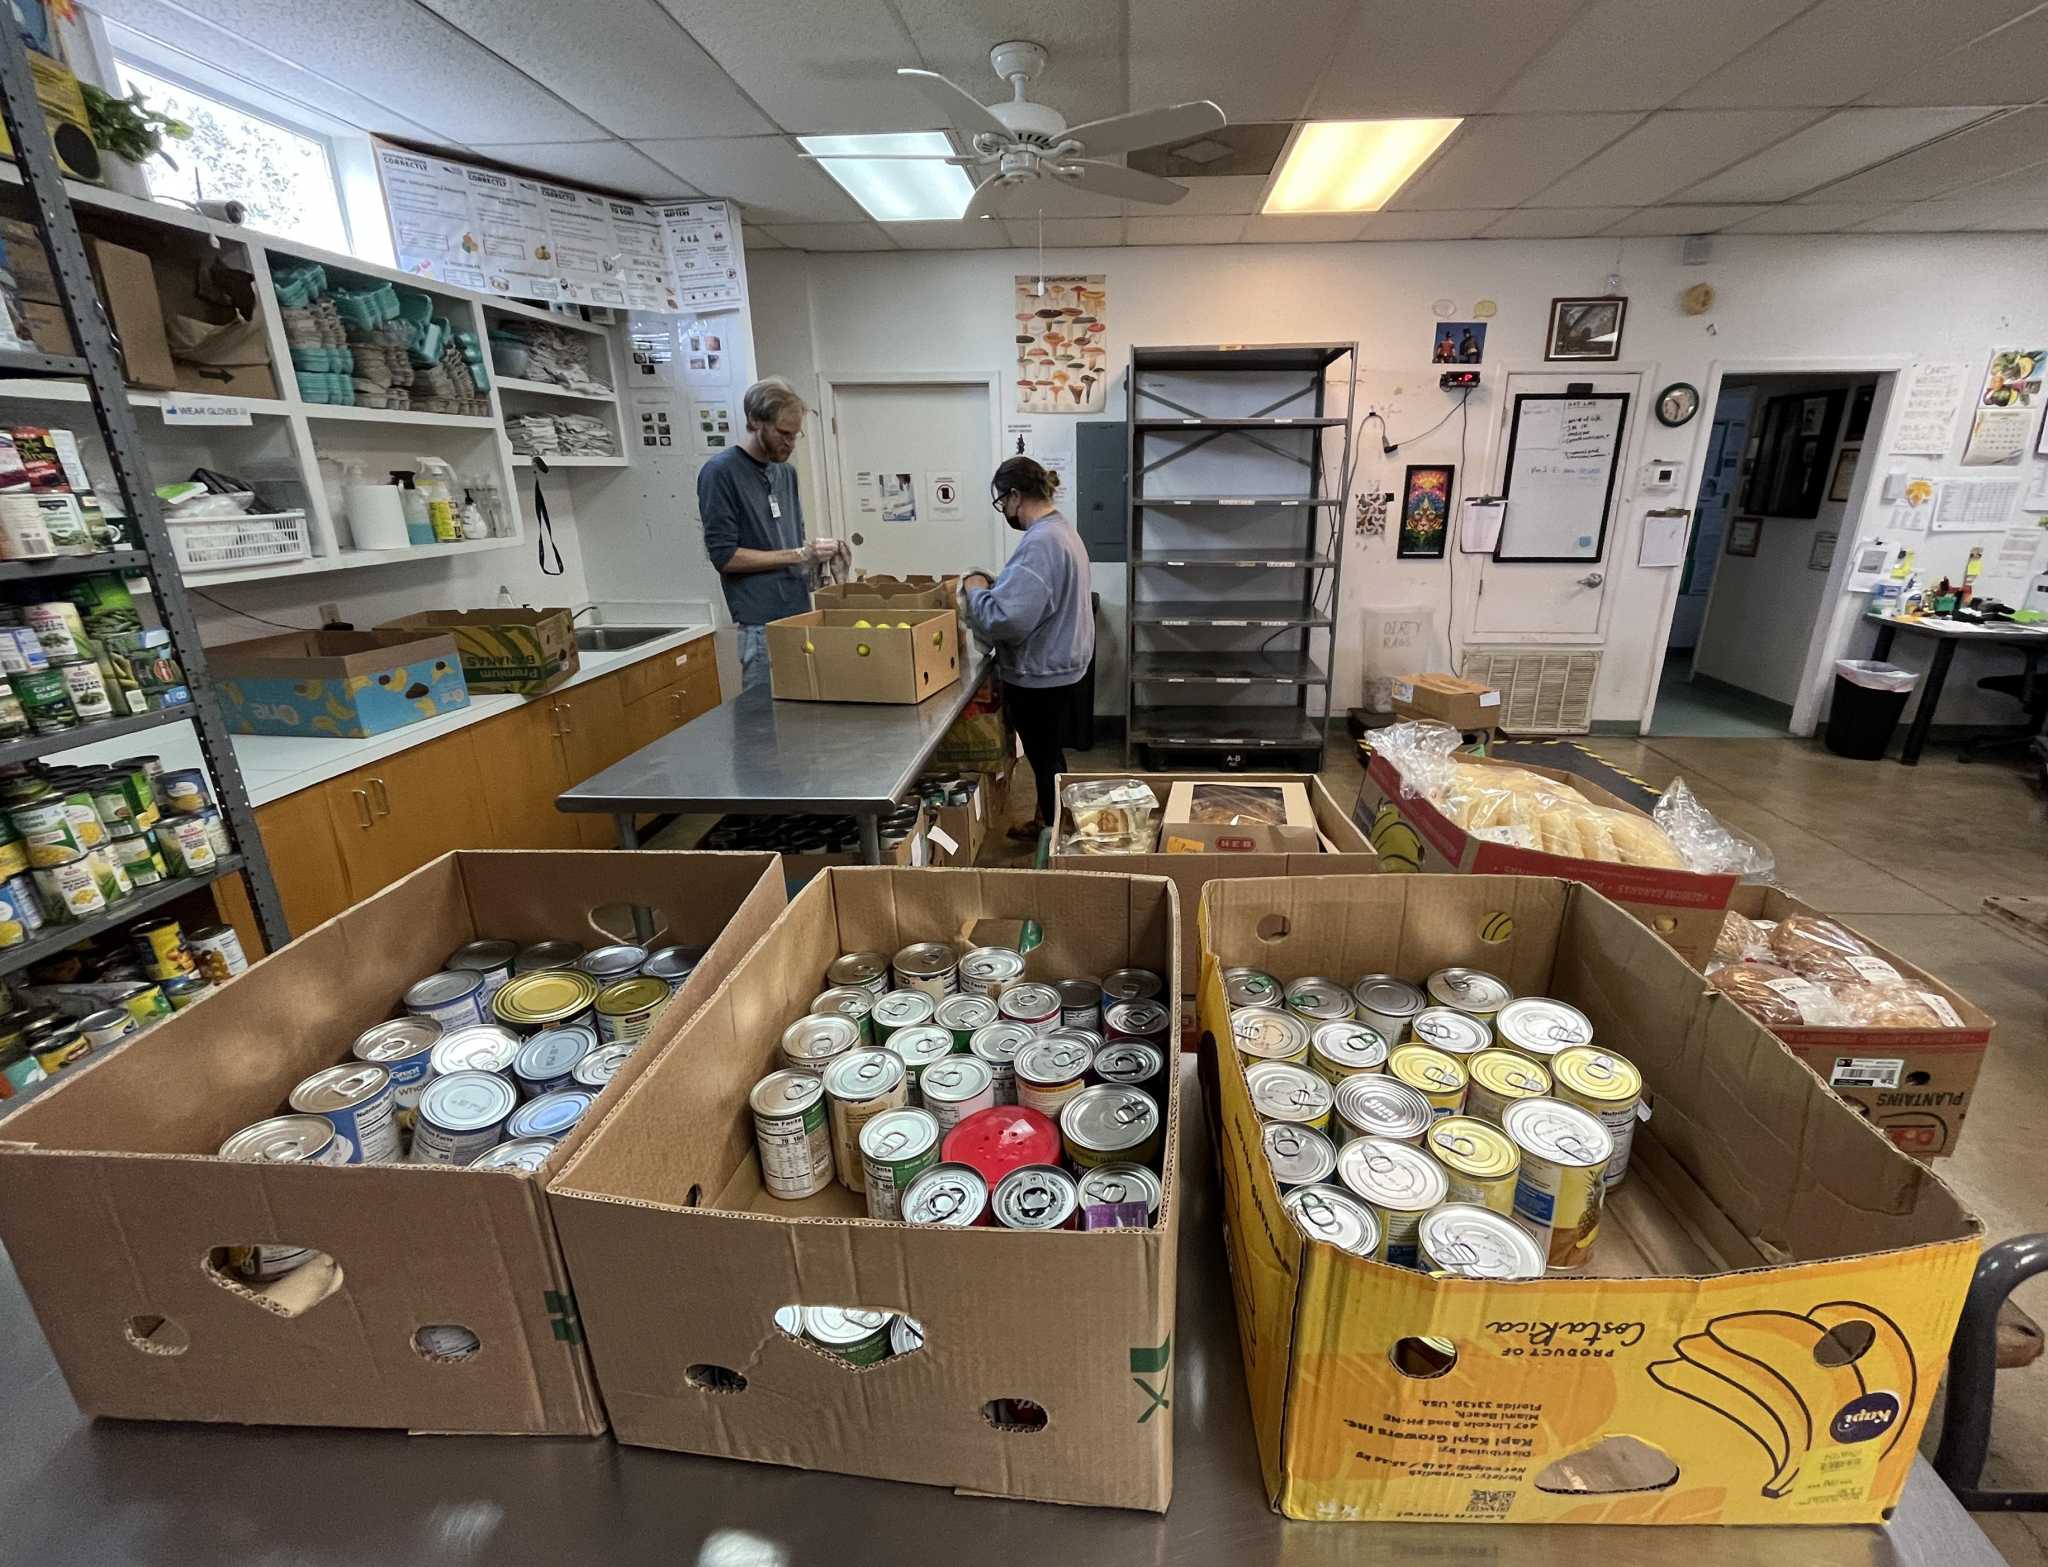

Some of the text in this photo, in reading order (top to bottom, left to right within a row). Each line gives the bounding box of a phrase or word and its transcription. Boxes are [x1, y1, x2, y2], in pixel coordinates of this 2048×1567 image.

[383, 157, 428, 171] CORRECTLY
[468, 174, 506, 187] CORRECTLY
[178, 407, 205, 415] WEAR
[1383, 620, 1422, 636] DIRTY
[1383, 636, 1411, 649] RAGS
[480, 668, 537, 679] Premium
[391, 1066, 420, 1078] Great
[1876, 1092, 1964, 1107] PLANTAINS
[1486, 1321, 1645, 1347] Costa Rica
[1501, 1347, 1615, 1358] PRODUCT OF
[1418, 1399, 1448, 1408] USA.
[1496, 1403, 1542, 1411] Florida
[1382, 1414, 1424, 1426] PH-NE
[1455, 1410, 1540, 1421] Miami Beach,
[1844, 1408, 1891, 1428] Kapi
[1428, 1419, 1460, 1428] Road
[1465, 1421, 1511, 1430] Lincoln
[1343, 1419, 1533, 1447] Kapi Kapi Growers Inc.
[1355, 1451, 1371, 1463] kg
[1438, 1446, 1532, 1458] Distributed by:
[1408, 1470, 1524, 1482] Variety: Cavendish
